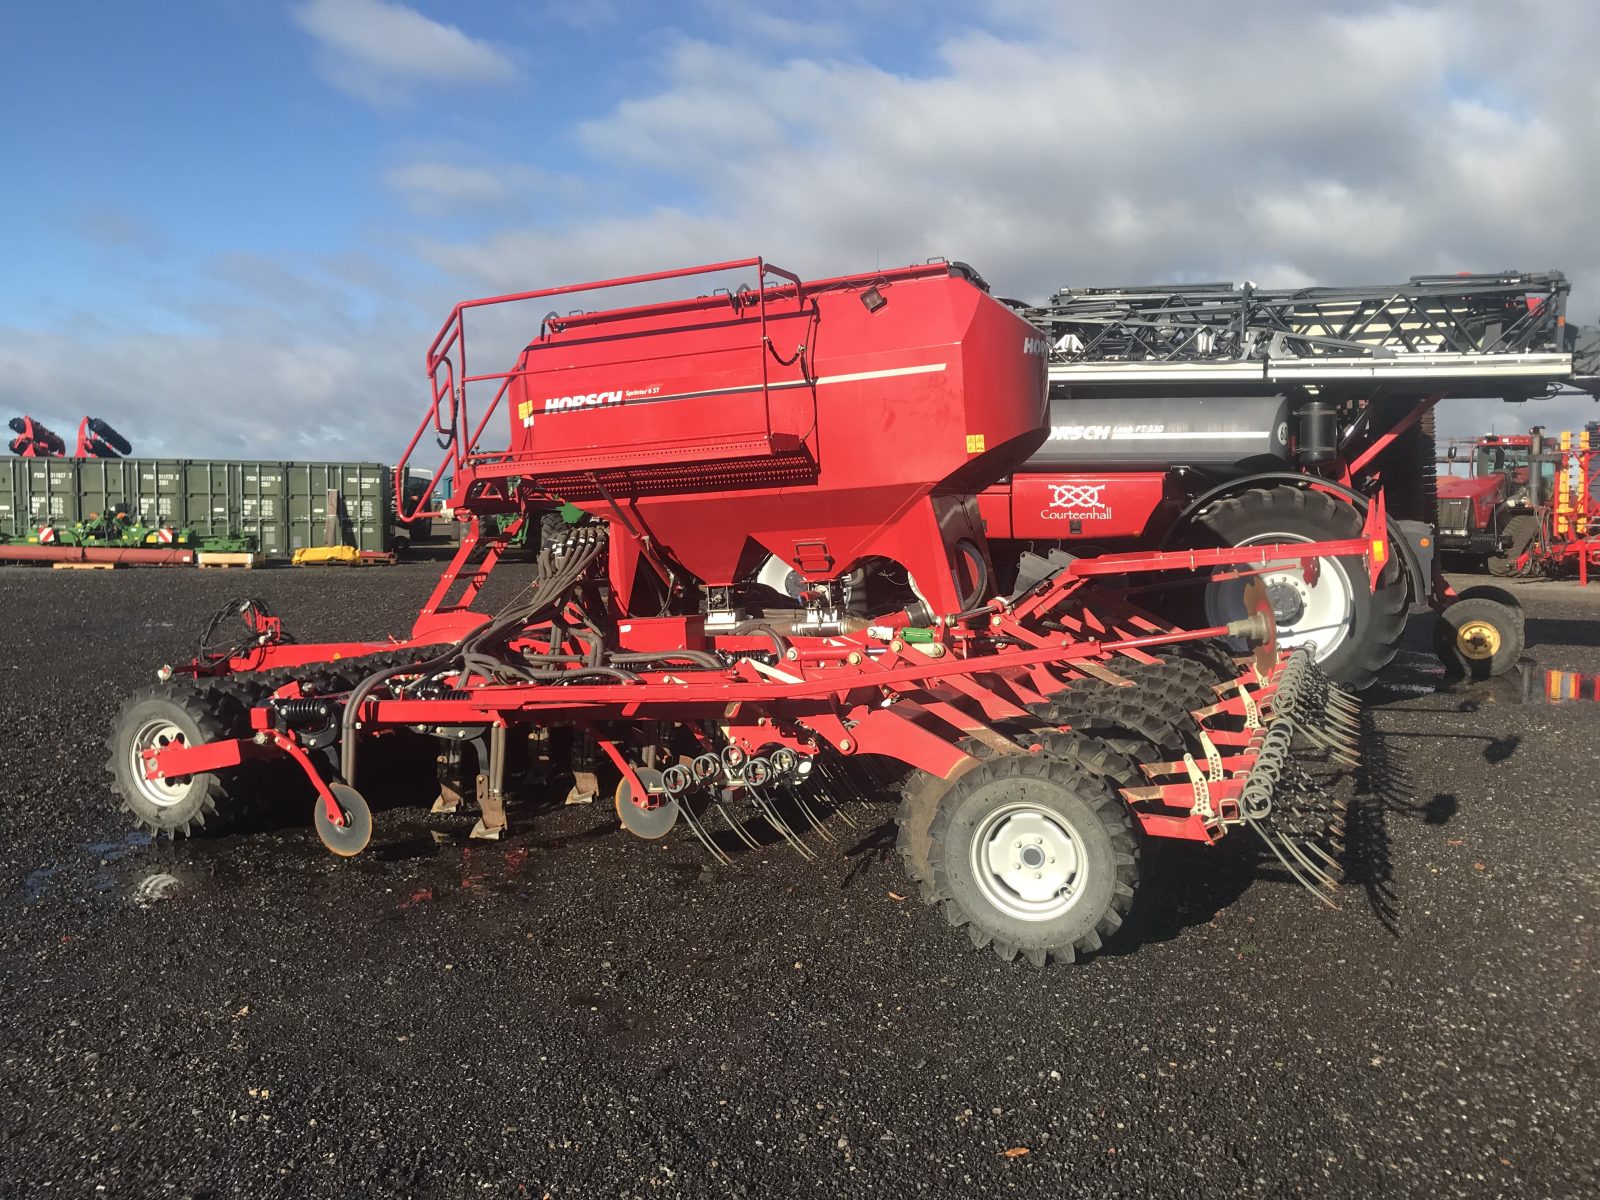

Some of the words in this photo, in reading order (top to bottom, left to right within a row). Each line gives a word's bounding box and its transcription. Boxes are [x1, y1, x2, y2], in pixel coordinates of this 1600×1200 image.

[544, 391, 623, 415] HORSCH
[625, 388, 648, 397] Sprinter
[1040, 507, 1112, 520] Courteenhall
